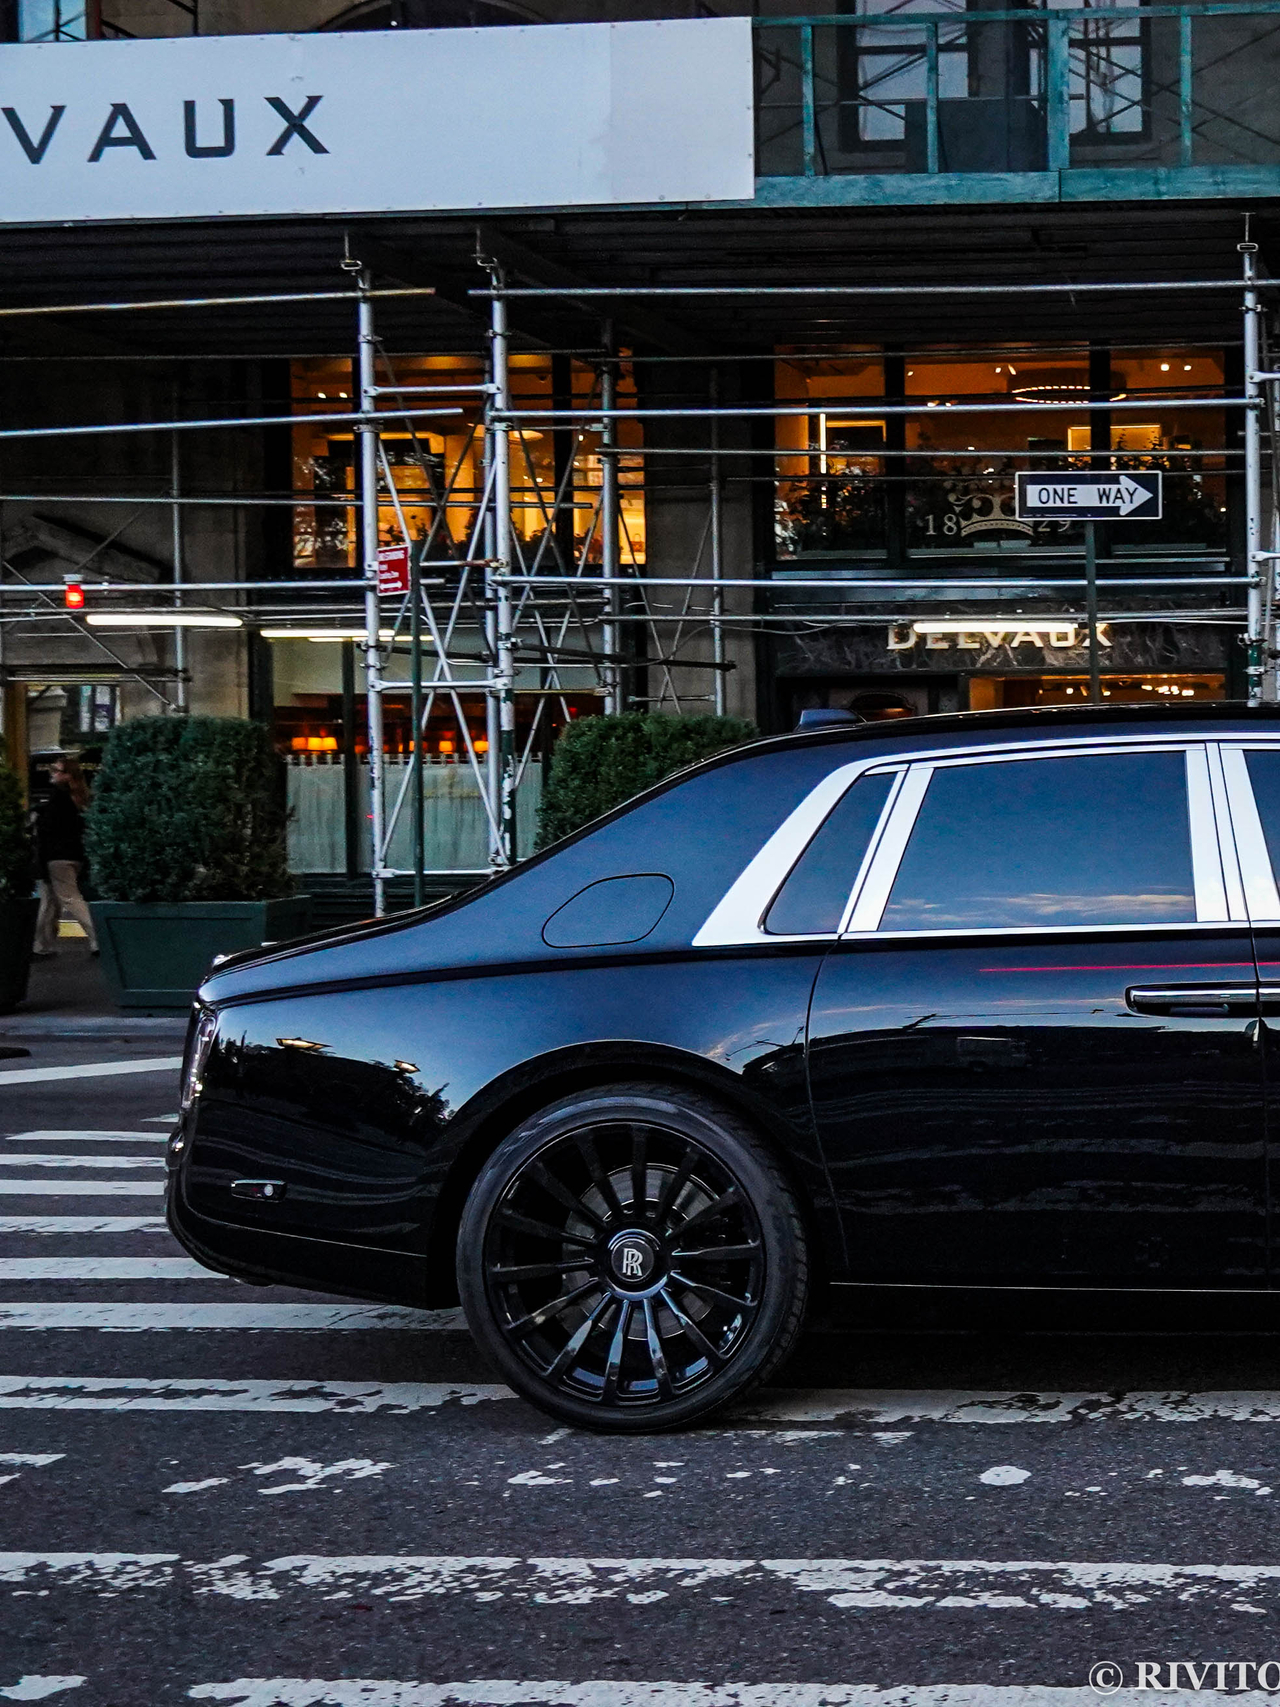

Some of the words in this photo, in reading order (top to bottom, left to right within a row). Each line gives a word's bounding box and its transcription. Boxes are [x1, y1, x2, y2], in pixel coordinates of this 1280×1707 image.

[1, 95, 330, 165] VAUX
[1038, 487, 1078, 505] ONE
[1097, 487, 1138, 505] WAY
